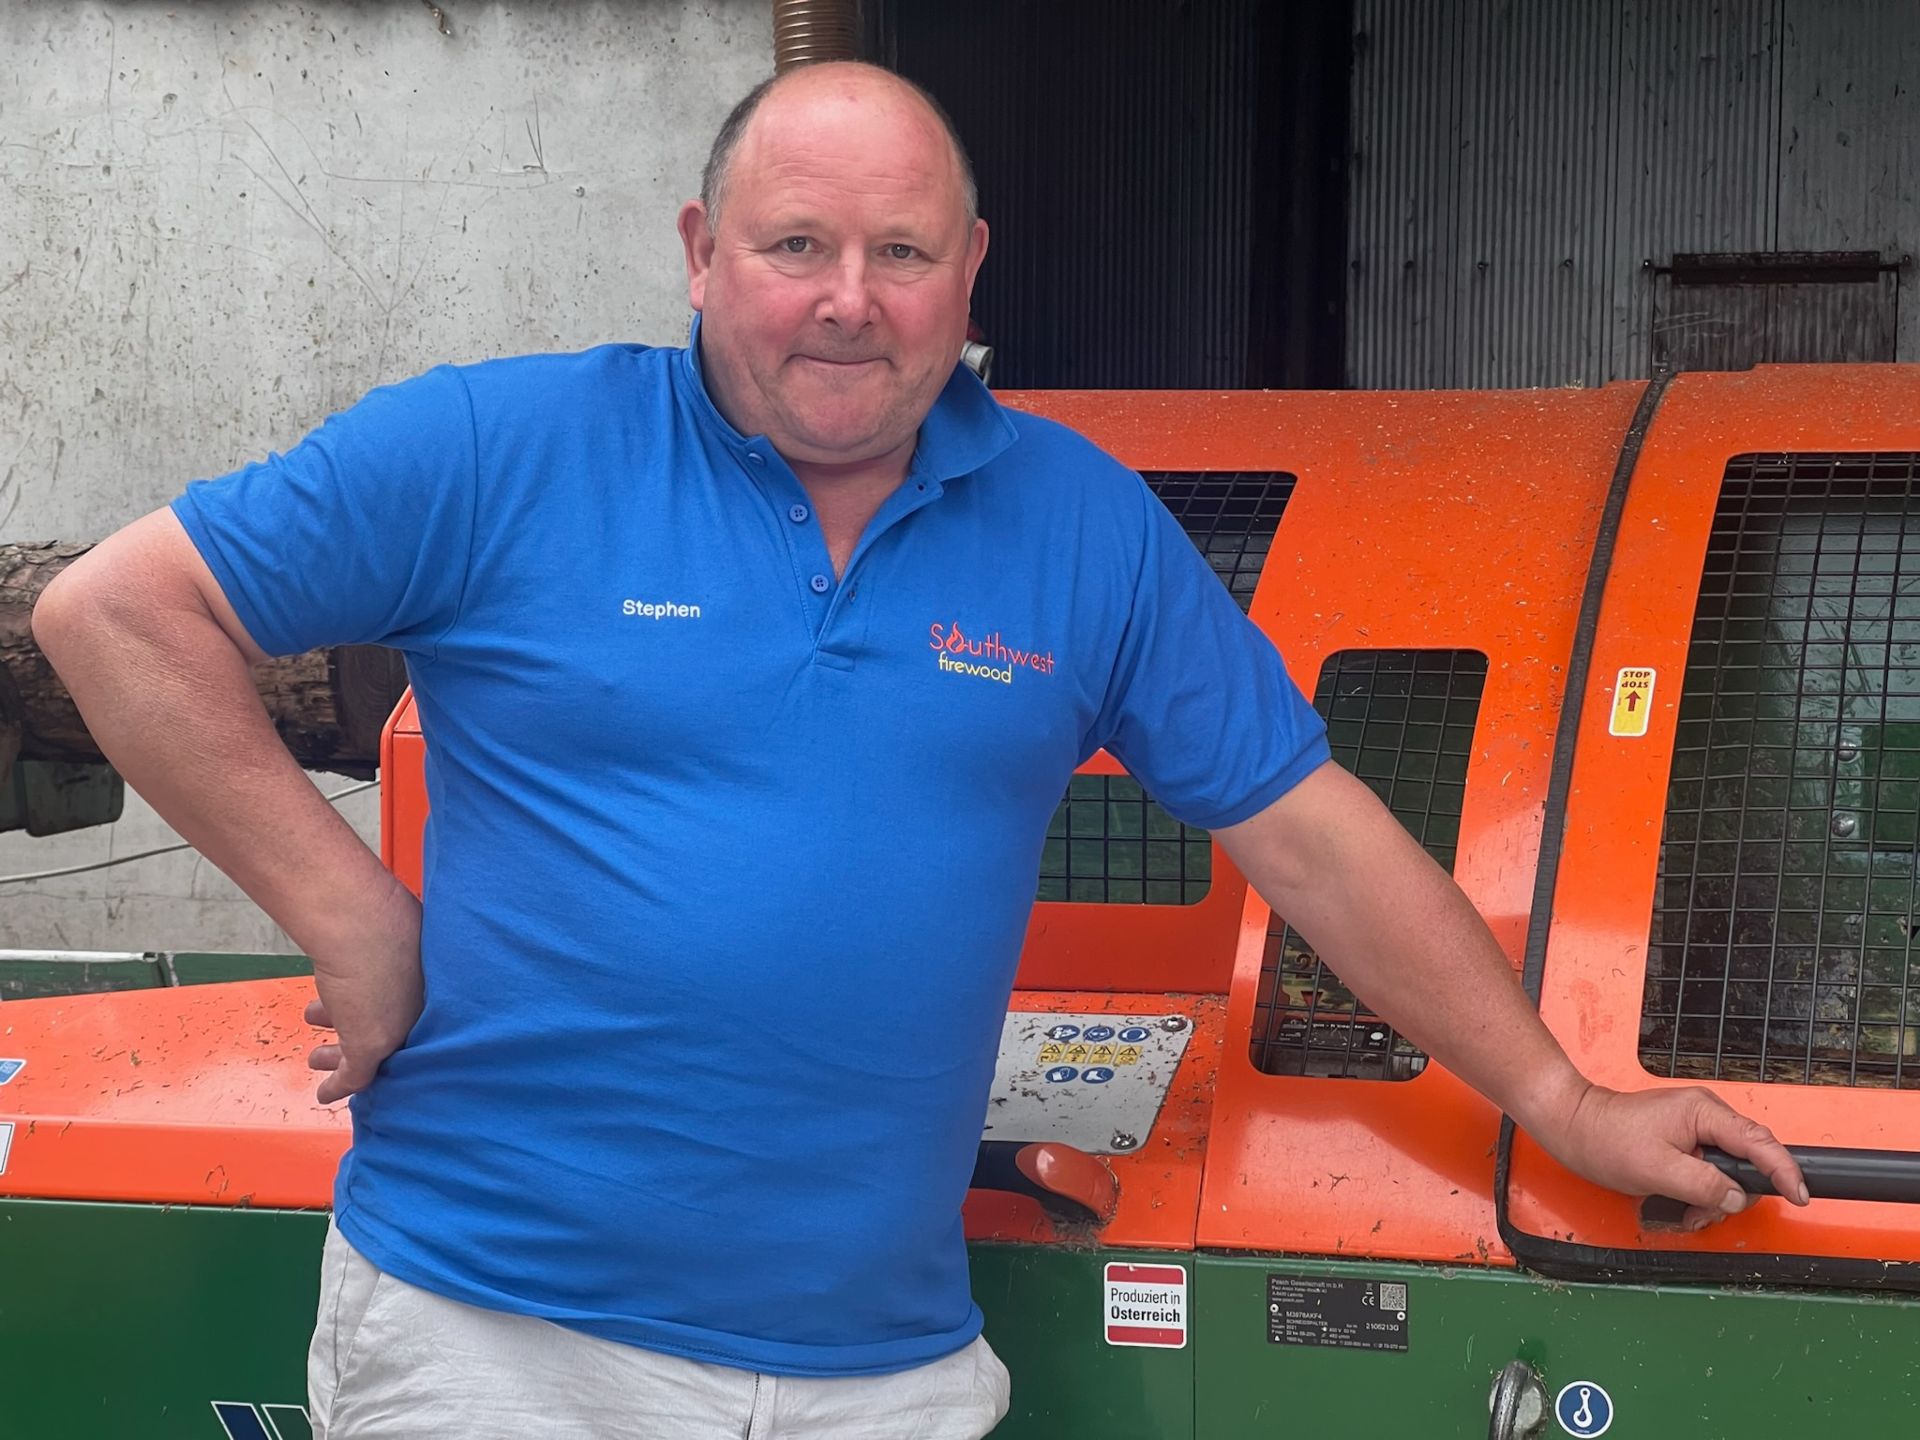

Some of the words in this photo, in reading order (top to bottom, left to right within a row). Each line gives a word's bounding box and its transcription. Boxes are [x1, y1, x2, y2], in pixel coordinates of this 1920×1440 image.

[622, 599, 701, 620] Stephen
[929, 621, 1055, 675] Southwest
[939, 651, 1012, 684] firewood
[1110, 1287, 1169, 1304] Produziert
[1170, 1290, 1181, 1305] in
[1110, 1305, 1181, 1323] Österreich
